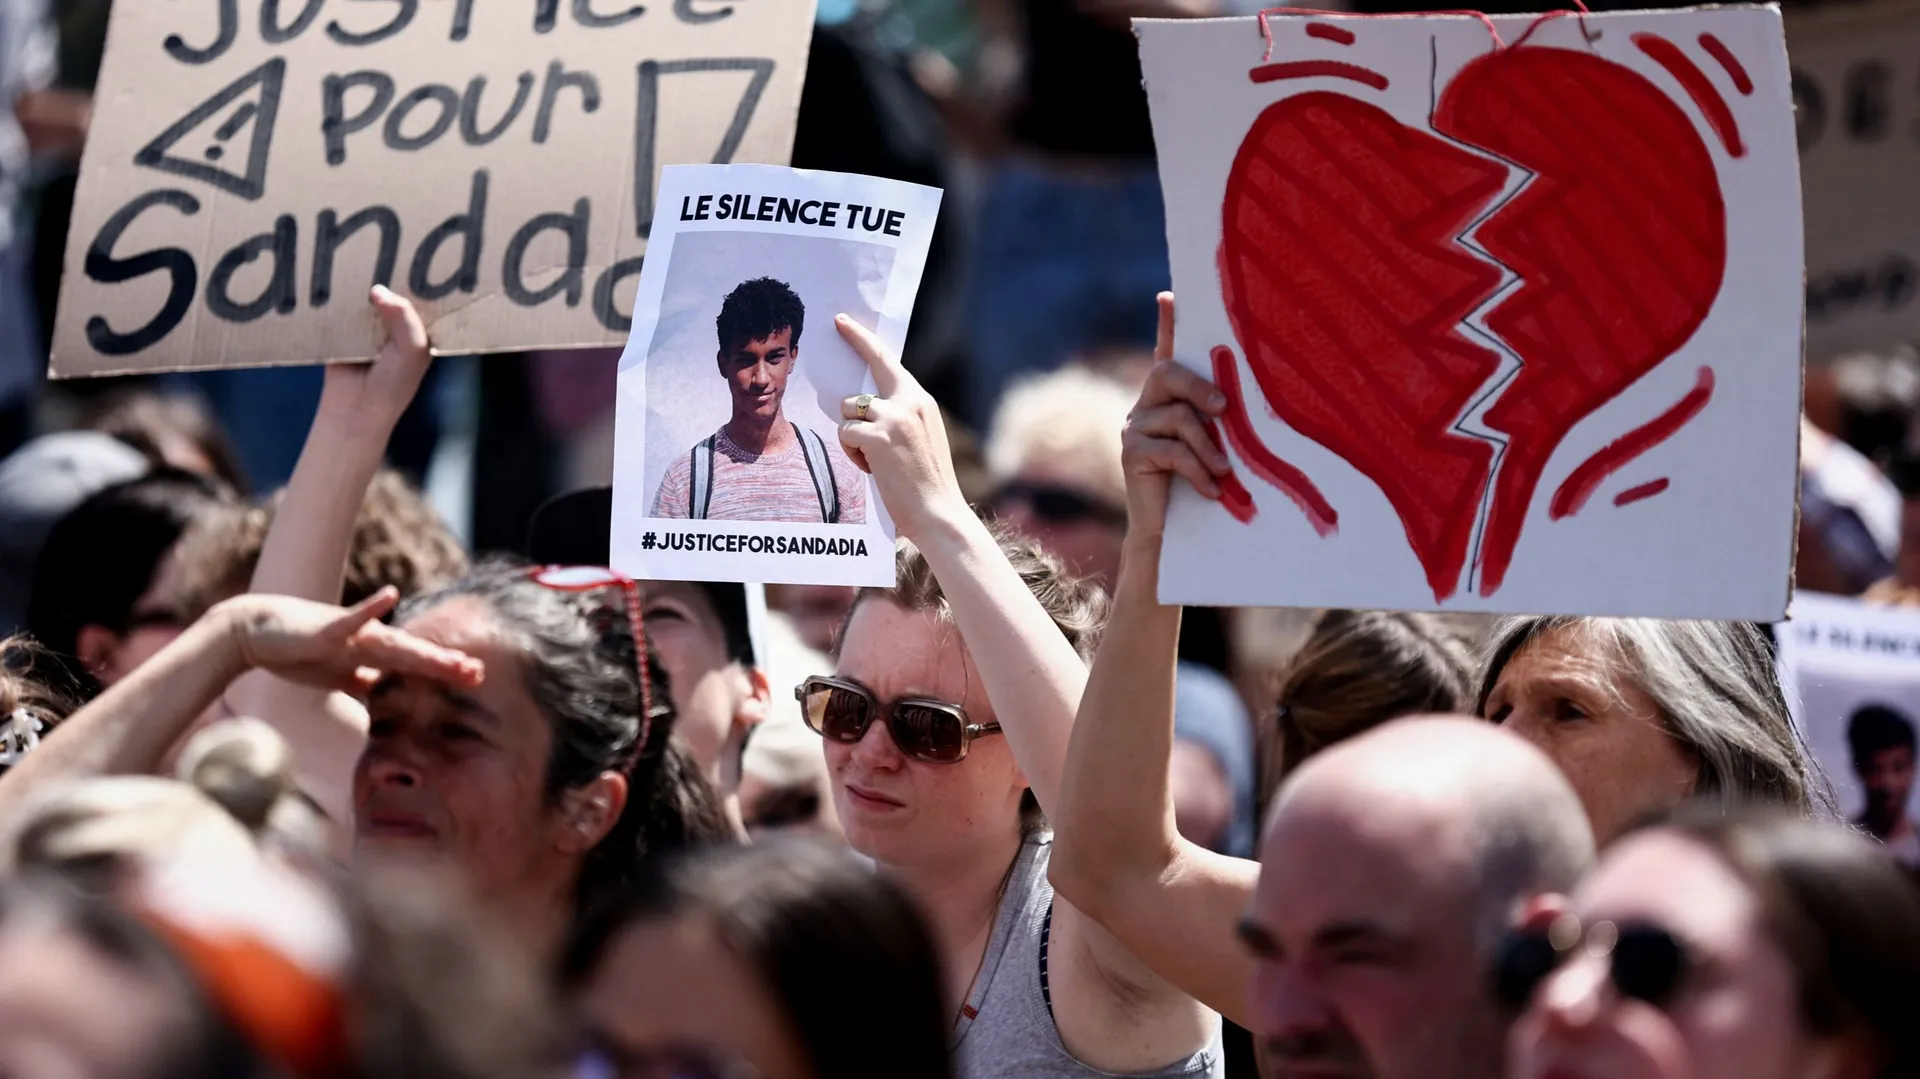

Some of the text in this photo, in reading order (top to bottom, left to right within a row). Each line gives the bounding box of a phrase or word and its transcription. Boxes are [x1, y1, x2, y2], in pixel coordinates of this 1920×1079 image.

[321, 60, 601, 165] pour
[680, 194, 905, 237] LE SILENCE TUE
[641, 531, 868, 557] #JUSTICEFORSANDADIA
